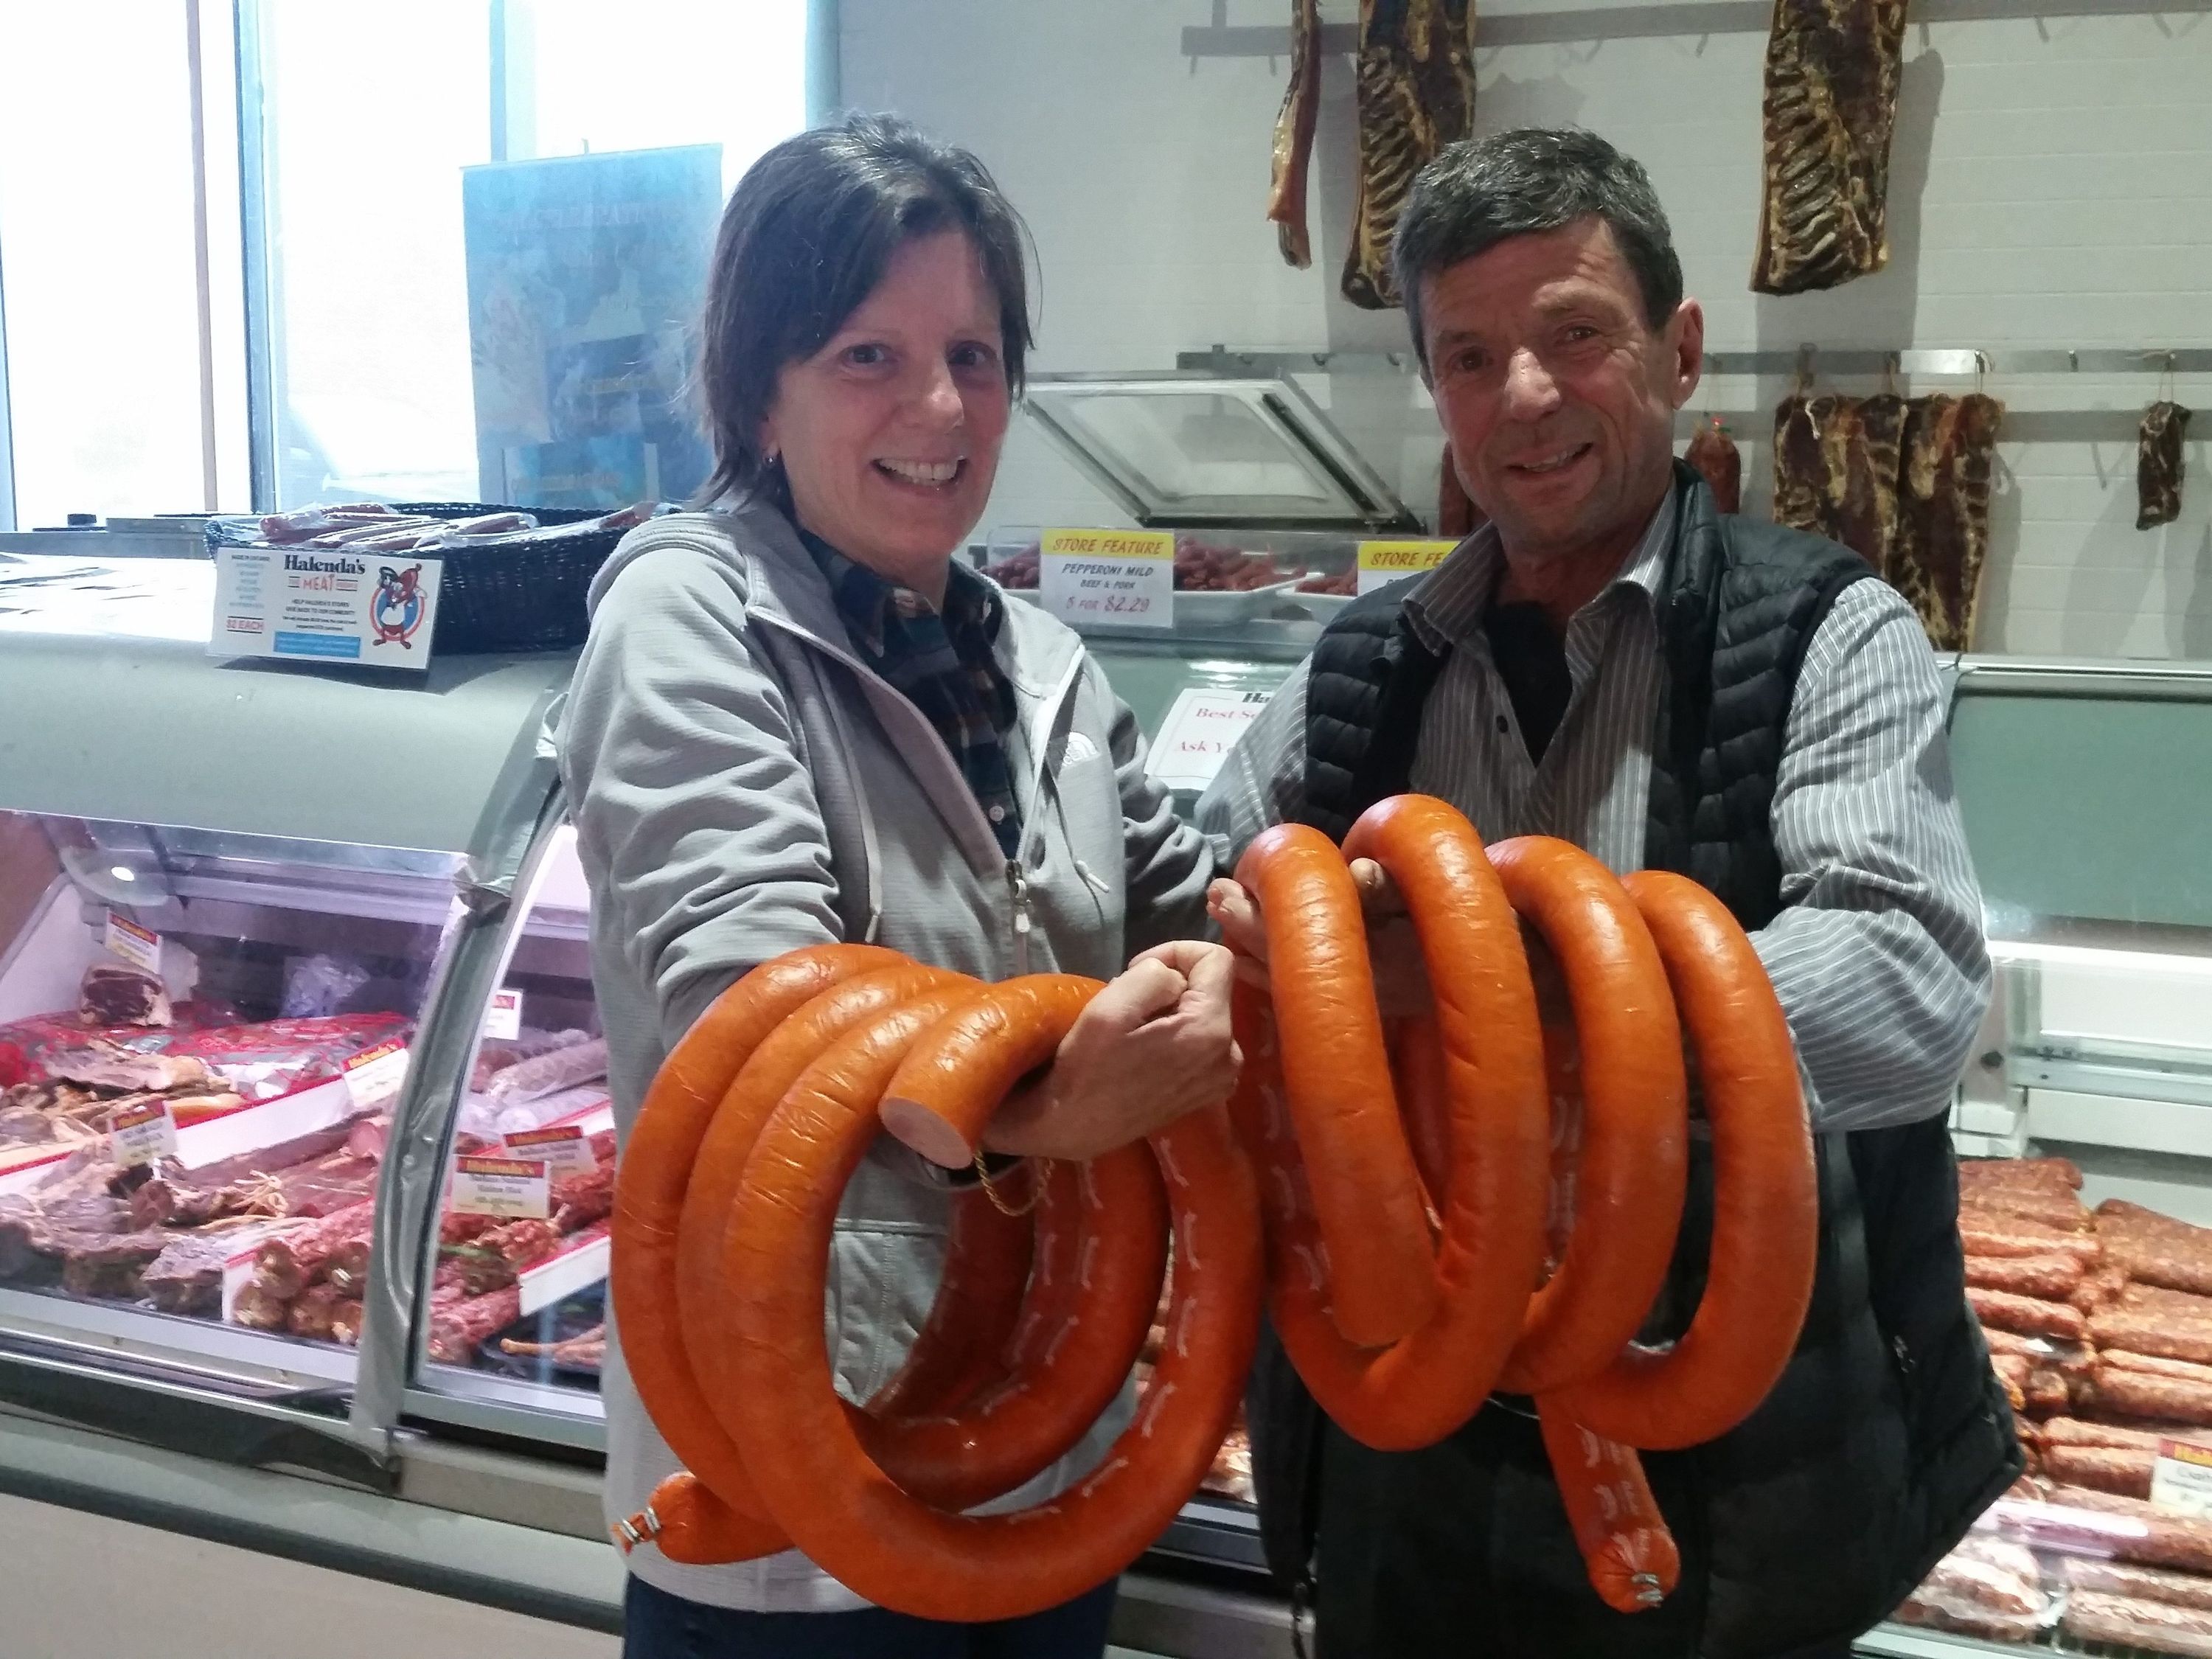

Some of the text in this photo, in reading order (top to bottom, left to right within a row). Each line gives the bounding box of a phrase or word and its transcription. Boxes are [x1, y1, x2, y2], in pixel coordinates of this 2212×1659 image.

[1053, 538, 1164, 554] STORE FEATURE
[284, 554, 366, 575] Halenda's
[1371, 552, 1419, 566] STORE
[1062, 563, 1154, 577] PEPPERONI MILD
[303, 574, 335, 591] MEAT
[1080, 580, 1102, 588] BEEF
[1113, 580, 1136, 589] PORK
[1079, 599, 1099, 611] FOR
[1104, 595, 1150, 612] $2.29
[1196, 708, 1234, 719] Best
